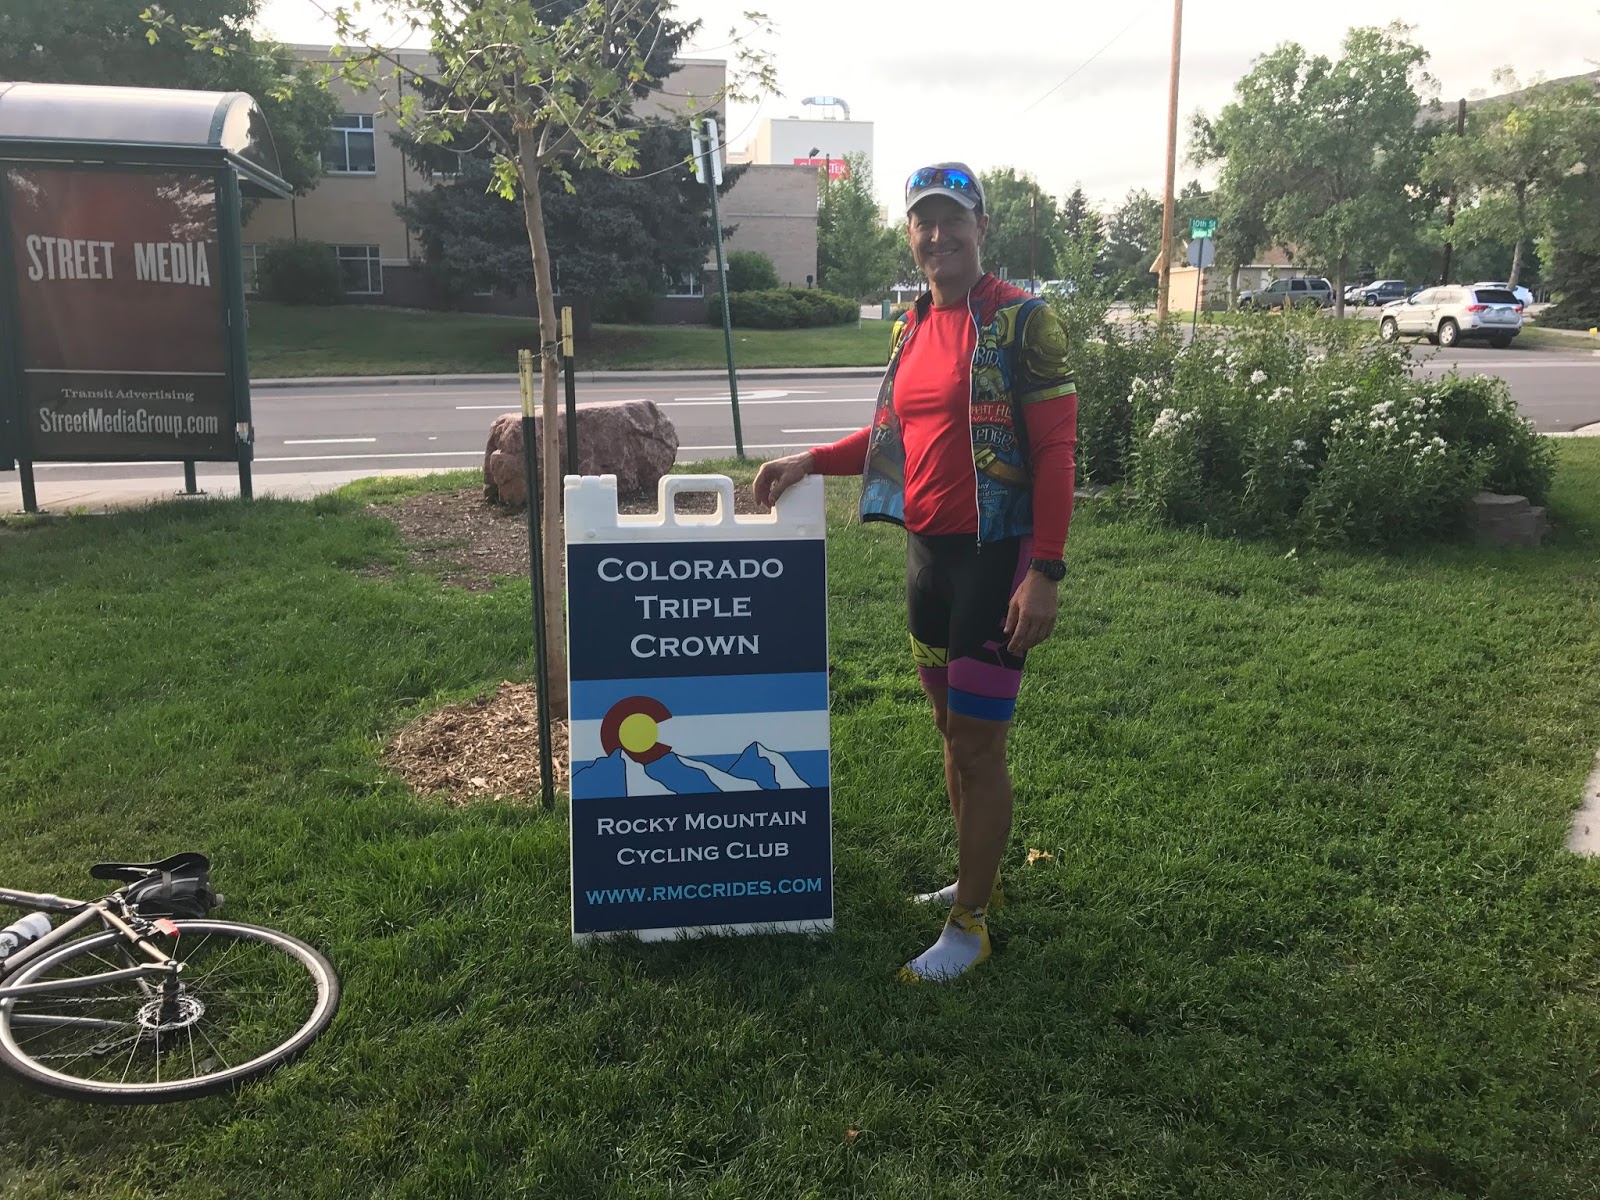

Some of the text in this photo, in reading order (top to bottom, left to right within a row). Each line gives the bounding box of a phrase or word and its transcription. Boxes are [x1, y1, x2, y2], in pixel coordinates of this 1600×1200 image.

[1192, 219, 1207, 227] 10th
[26, 234, 211, 287] STREET MEDIA
[61, 388, 194, 402] Transit Advertising
[39, 407, 218, 438] StreetMediaGroup.com
[597, 557, 784, 582] COLORADO
[634, 595, 752, 619] TRIPLE
[630, 633, 760, 658] CROWN
[597, 810, 807, 835] ROCKY MOUNTAIN
[616, 841, 789, 866] CYCLING CLUB
[585, 877, 822, 905] WWW.RMCCRIDES.COM
